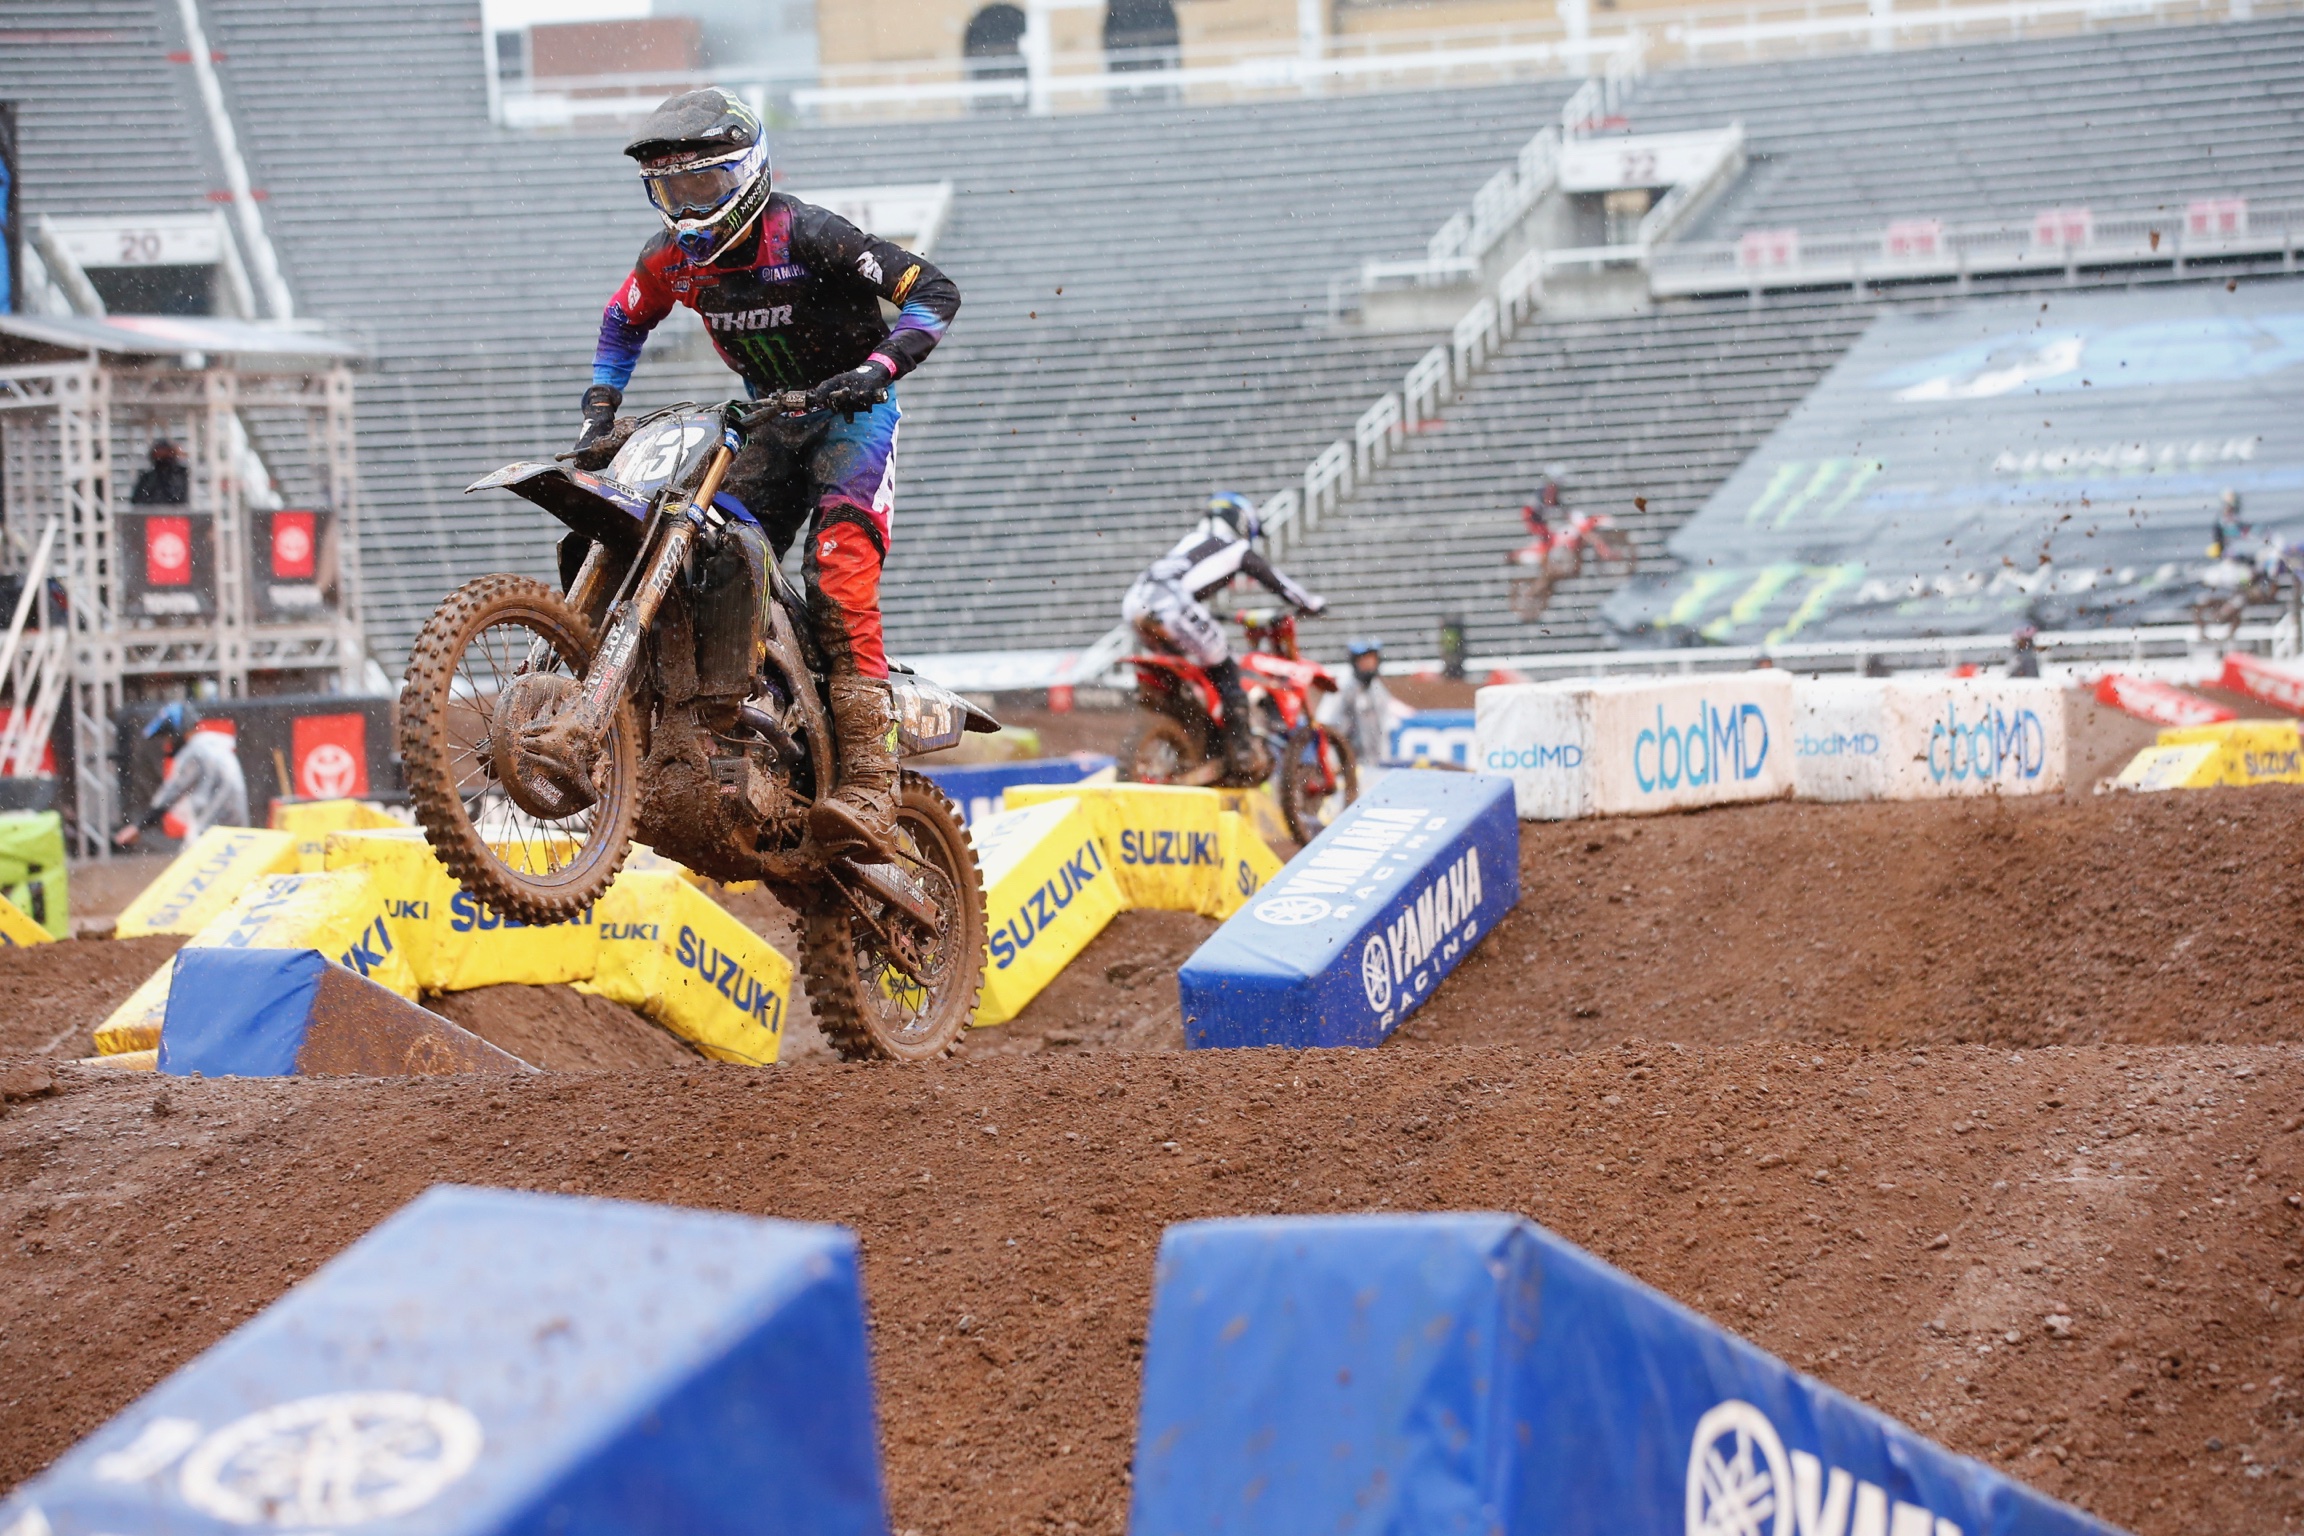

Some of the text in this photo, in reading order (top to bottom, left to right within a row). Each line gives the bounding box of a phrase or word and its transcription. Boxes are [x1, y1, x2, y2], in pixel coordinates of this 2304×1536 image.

[119, 233, 161, 260] 20
[705, 304, 794, 331] THOR
[1487, 744, 1583, 769] cbdMD
[1634, 699, 1769, 793] cbdMD
[1928, 701, 2044, 783] cbdMD
[147, 835, 256, 926] SUZUKI
[1121, 829, 1220, 867] SUZUKI
[1278, 808, 1430, 895] YAMAHA
[1333, 816, 1448, 920] RACING
[989, 839, 1103, 970] SUZUKI
[1387, 846, 1482, 985] YAMAHA
[676, 925, 782, 1033] SUZUKI
[1380, 920, 1478, 1031] RACING
